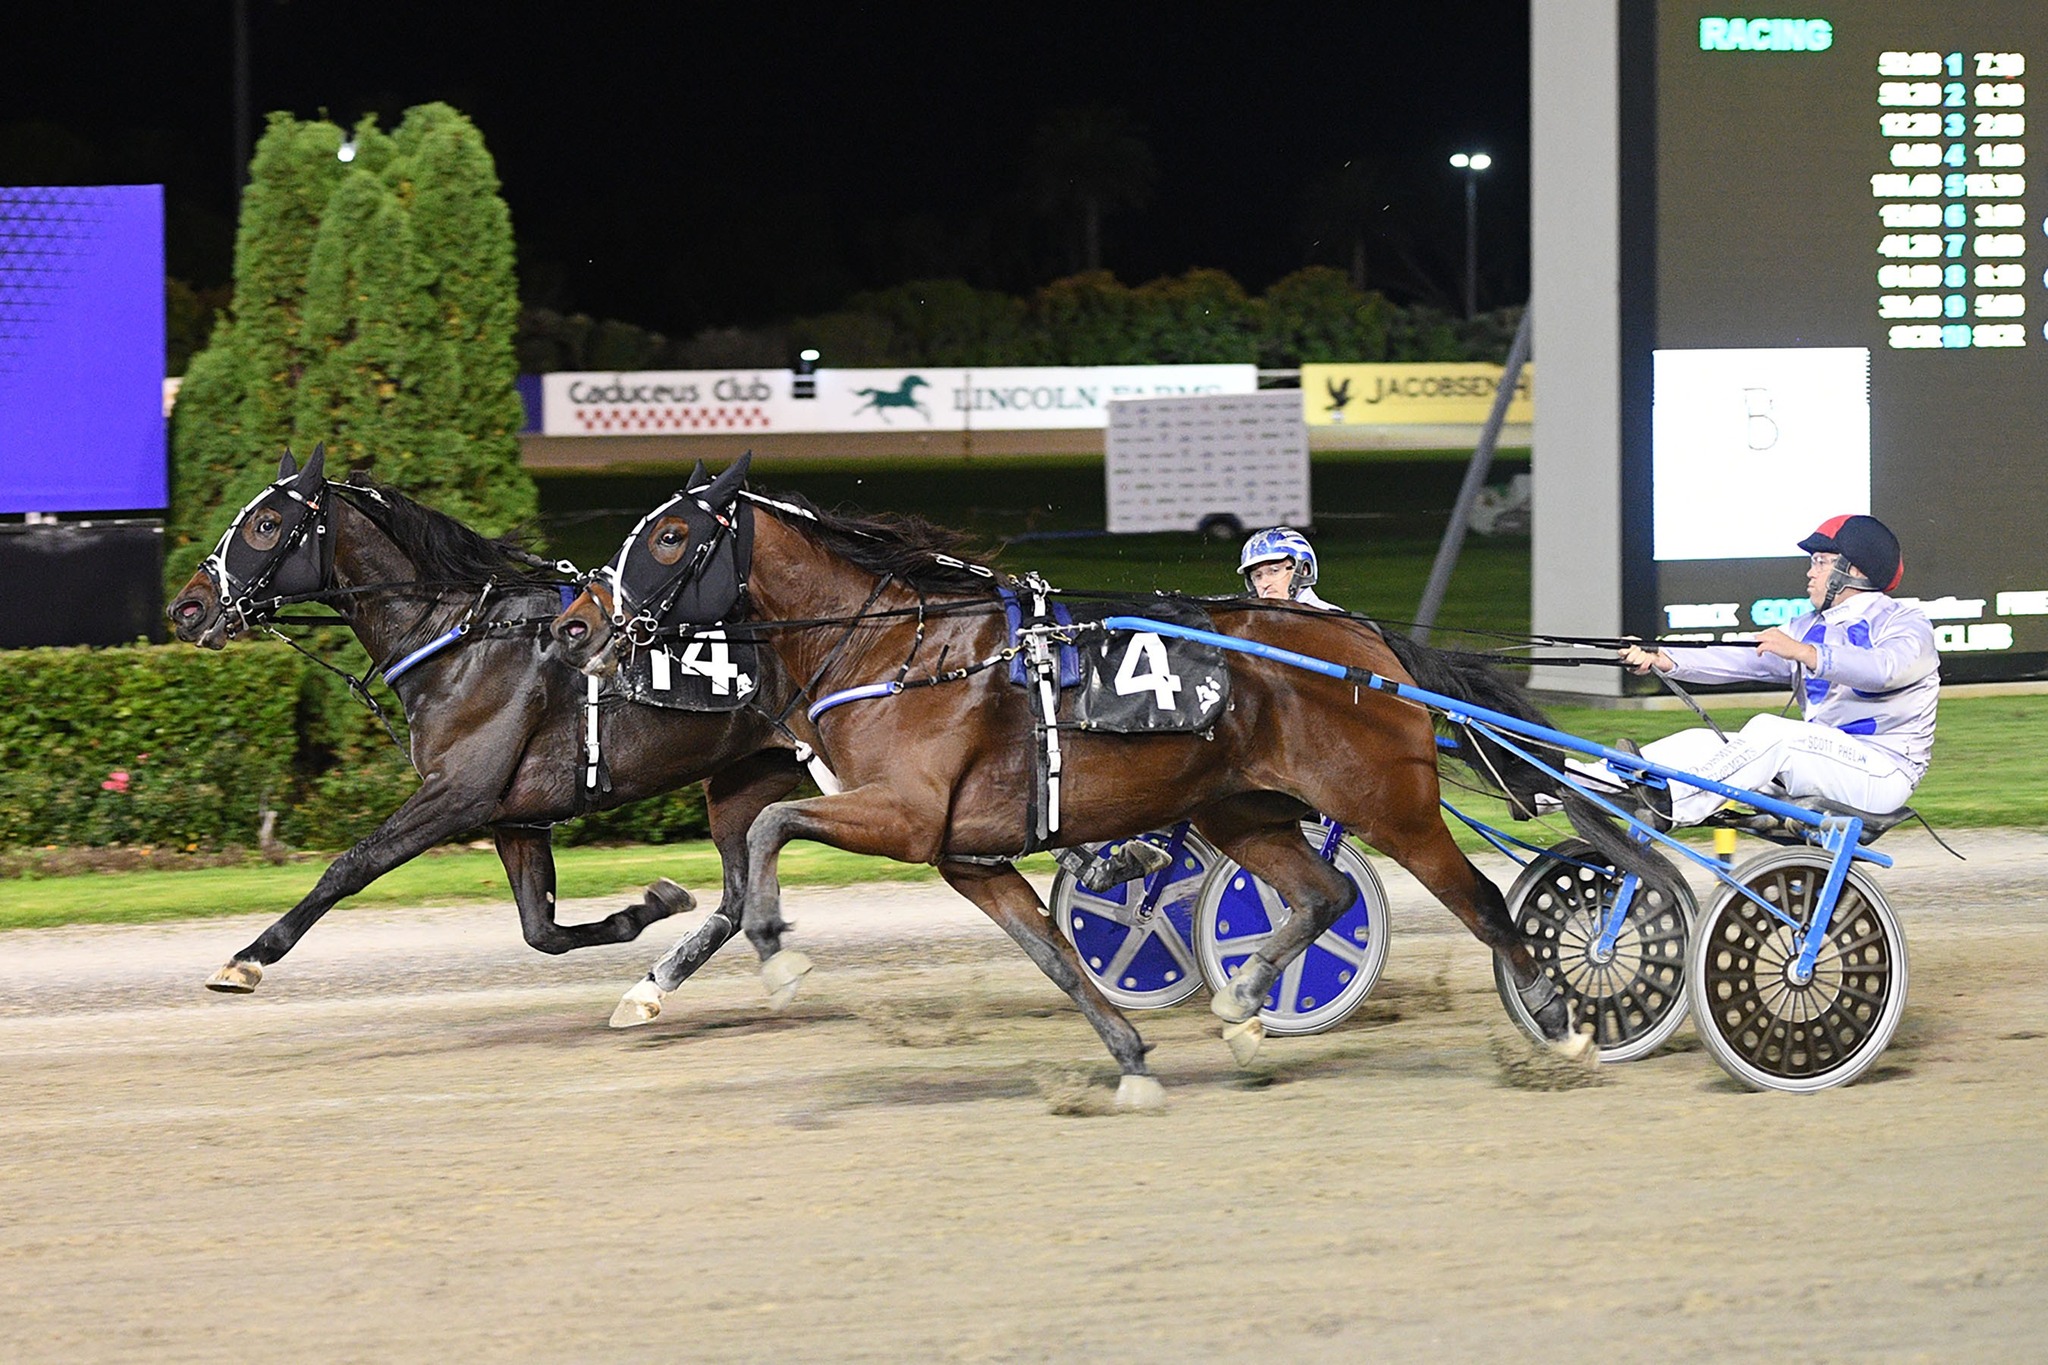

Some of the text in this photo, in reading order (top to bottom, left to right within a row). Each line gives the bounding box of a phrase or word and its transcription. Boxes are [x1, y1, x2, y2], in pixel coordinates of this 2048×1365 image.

[1699, 17, 1833, 51] RACING
[1944, 52, 1963, 76] 1
[1943, 82, 1966, 107] 2
[1944, 113, 1966, 137] 3
[1943, 143, 1967, 167] 4
[1943, 234, 1966, 258] 7
[569, 375, 771, 404] Caduceus Club
[953, 384, 1098, 411] LINCOLN
[650, 630, 738, 696] 14
[1114, 632, 1182, 710] 4
[1808, 735, 1833, 753] SCOTT
